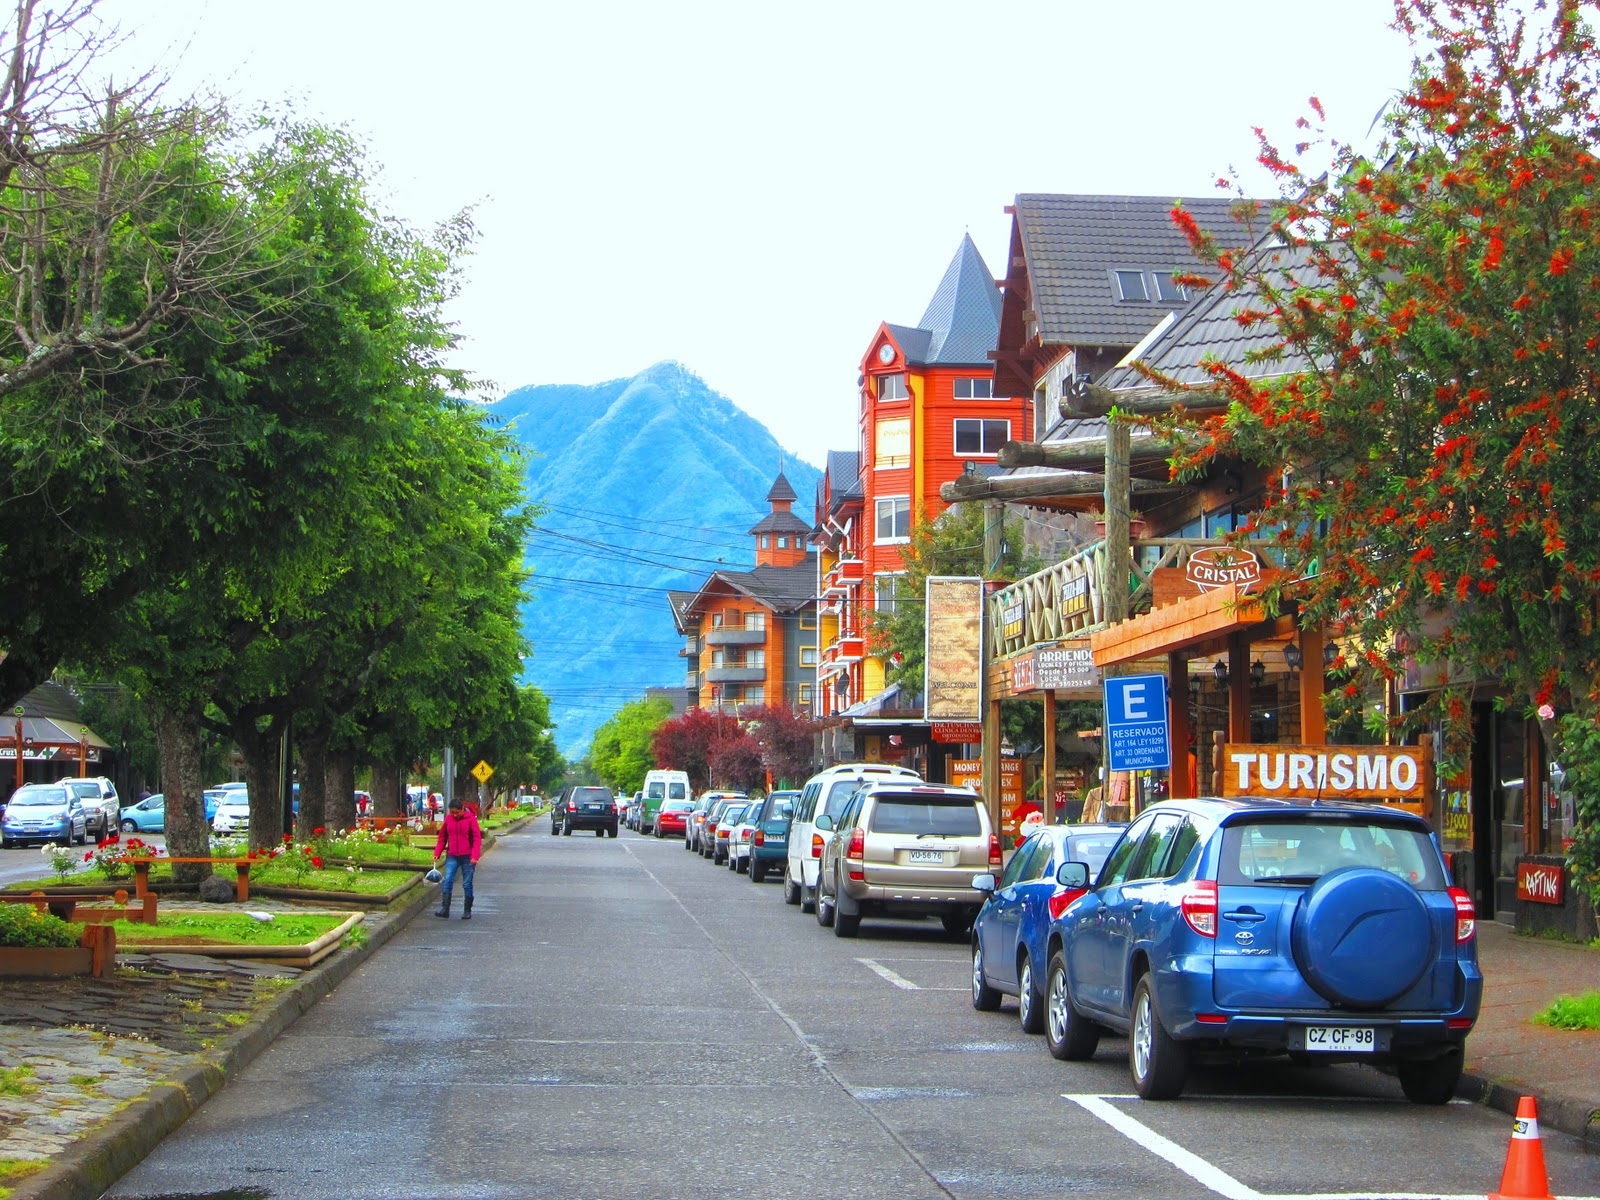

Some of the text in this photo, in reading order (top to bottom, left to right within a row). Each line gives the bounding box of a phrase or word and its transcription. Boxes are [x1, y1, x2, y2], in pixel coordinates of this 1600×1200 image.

[1193, 564, 1256, 582] CRISTAL
[1122, 683, 1148, 720] E
[1112, 726, 1165, 739] RESERVADO
[1148, 736, 1164, 745] 18290
[1133, 745, 1165, 756] ORDENANZA
[953, 763, 980, 772] MONEY
[1124, 756, 1155, 766] MUNICIPAL
[1230, 753, 1418, 791] TURISMO
[1525, 869, 1557, 899] RAFTING
